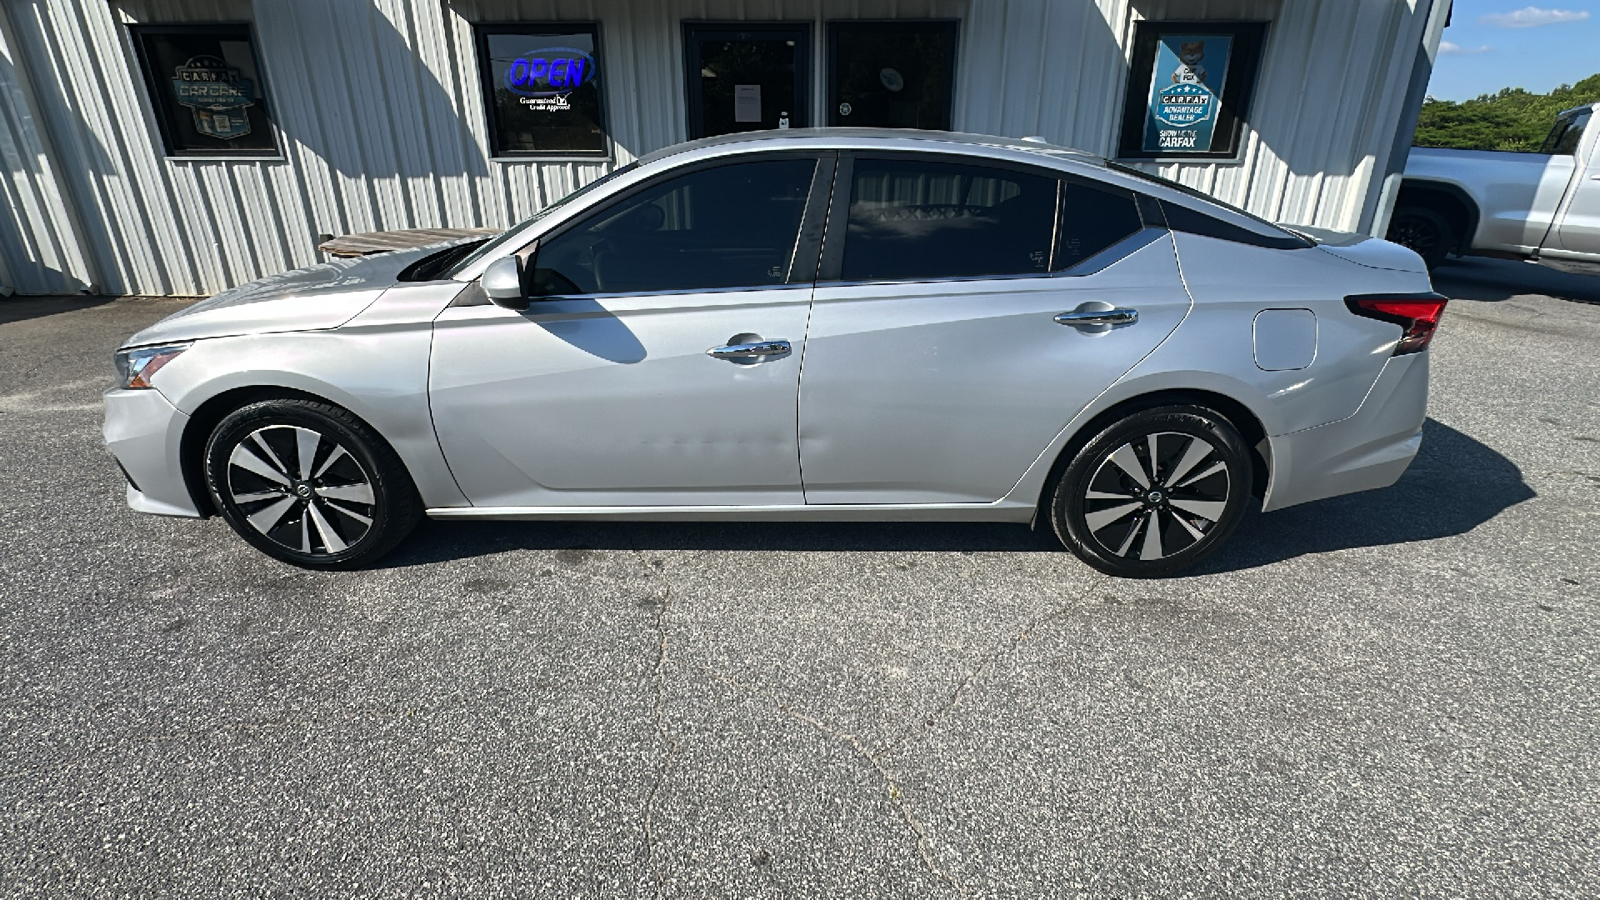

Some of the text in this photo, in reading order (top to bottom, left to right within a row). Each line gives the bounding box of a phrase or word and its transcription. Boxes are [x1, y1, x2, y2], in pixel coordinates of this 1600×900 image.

[182, 71, 237, 81] CARFAX
[510, 58, 585, 87] OPEN
[179, 85, 208, 96] CAR
[1162, 95, 1209, 104] CARFAX
[1163, 106, 1203, 114] ADVANTAGE
[1158, 137, 1196, 148] CARFAX
